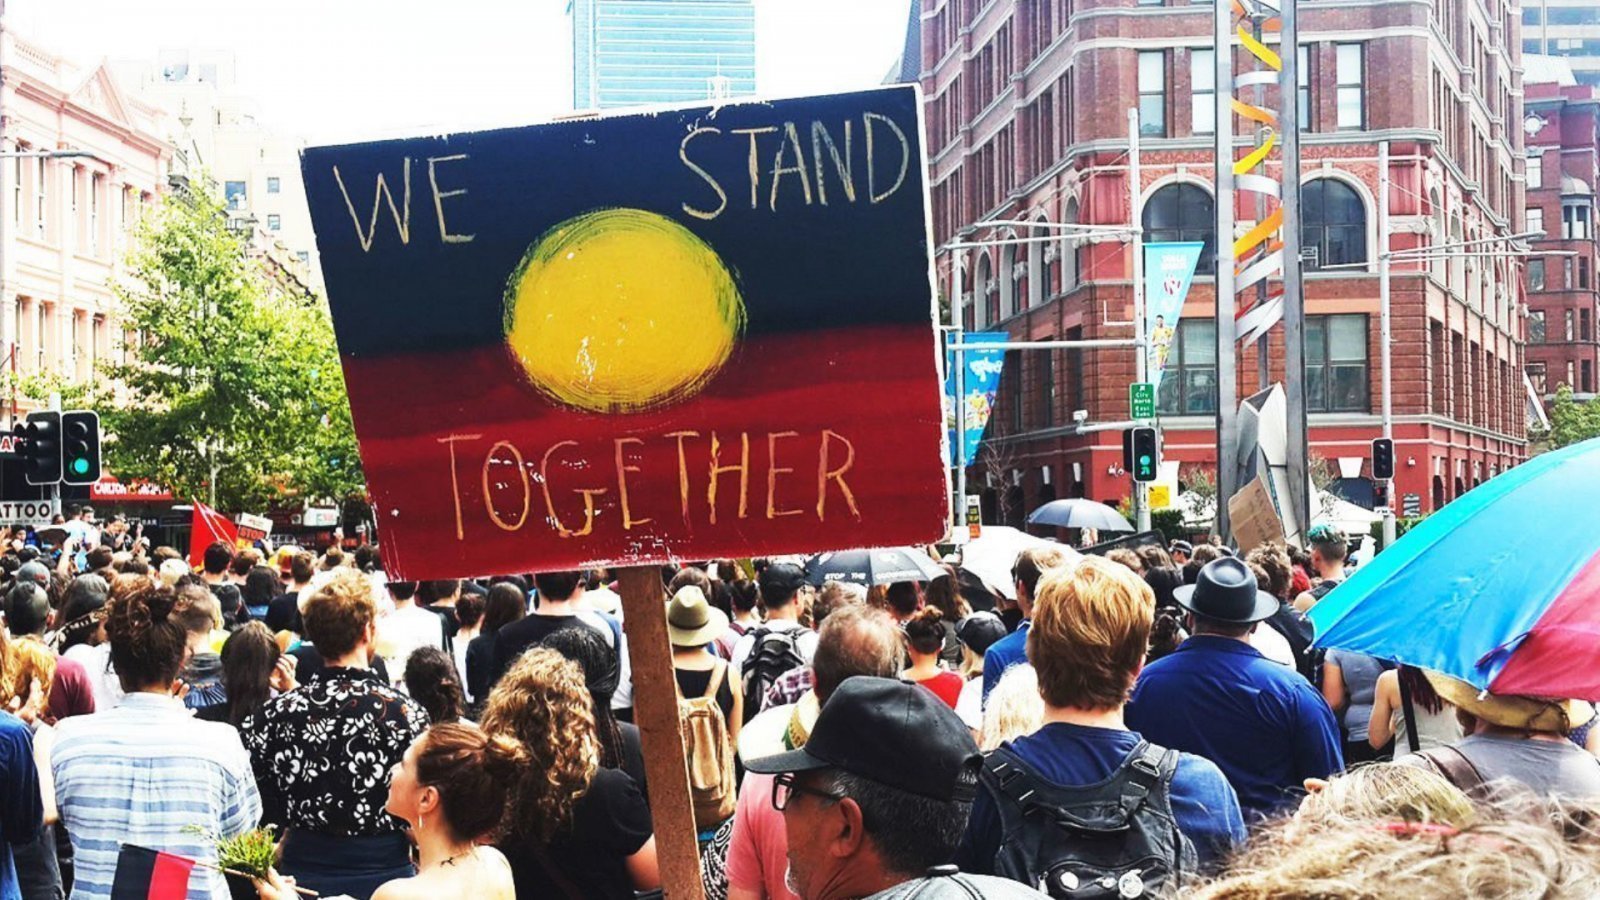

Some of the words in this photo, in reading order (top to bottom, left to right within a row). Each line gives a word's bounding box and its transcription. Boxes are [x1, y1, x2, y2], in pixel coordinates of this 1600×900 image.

[333, 154, 476, 252] WE
[680, 112, 910, 220] STAND
[437, 429, 860, 540] TOGETHER
[240, 526, 266, 540] STOP
[824, 572, 845, 580] STOP
